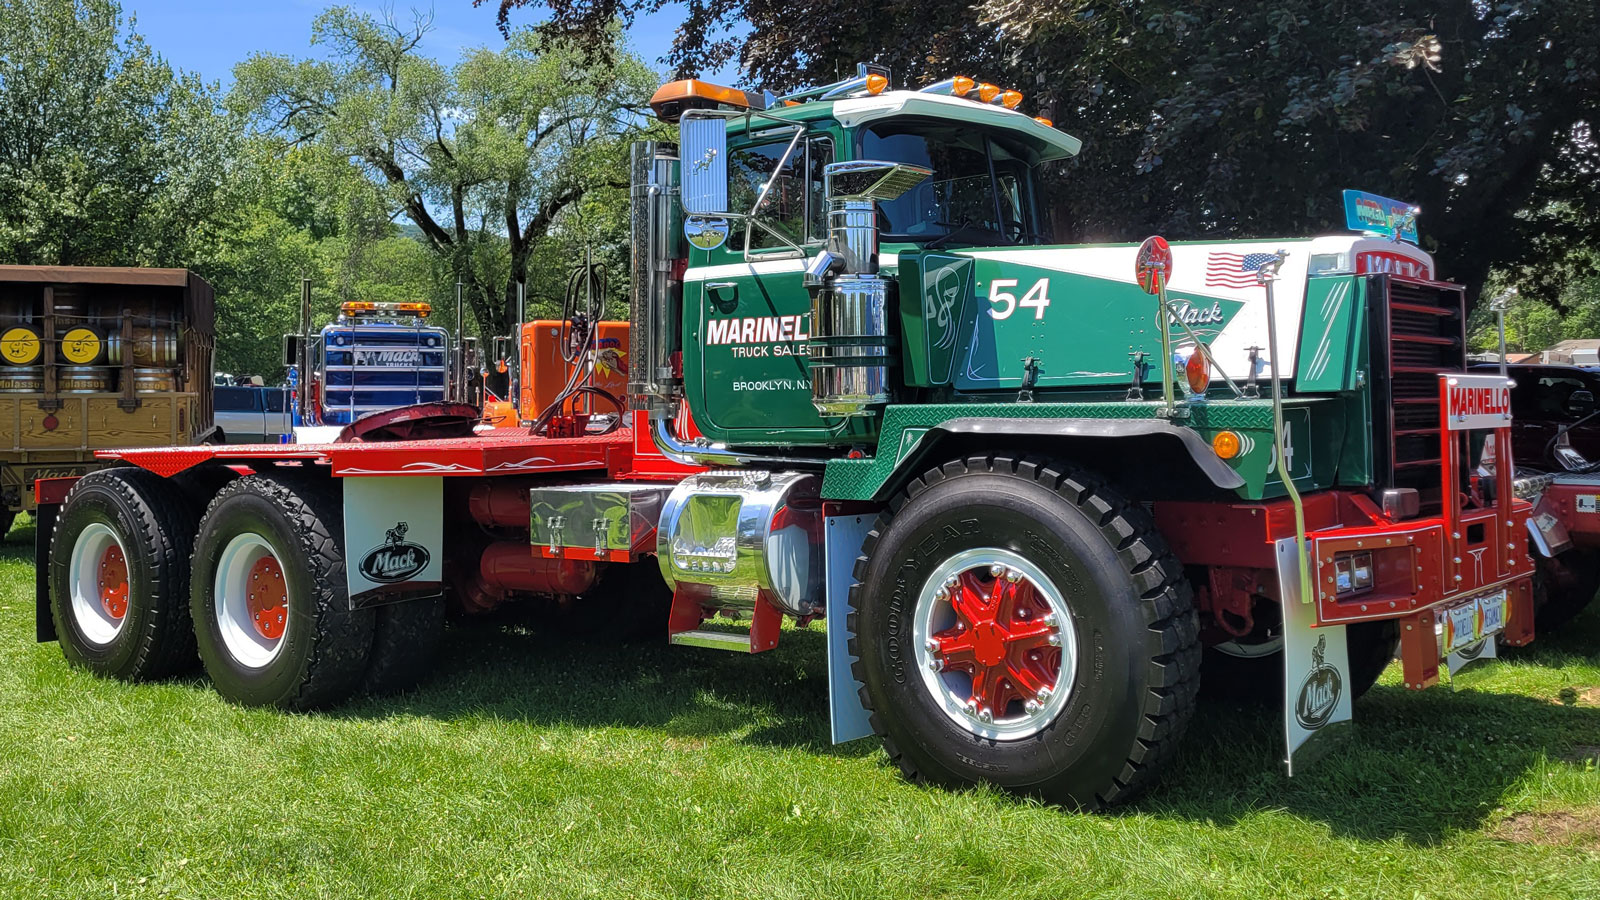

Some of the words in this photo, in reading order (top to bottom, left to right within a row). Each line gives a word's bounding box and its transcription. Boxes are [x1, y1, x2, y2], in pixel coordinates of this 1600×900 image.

[988, 277, 1050, 320] 54
[1167, 301, 1223, 324] Mack
[707, 315, 810, 345] MARINEL
[377, 351, 420, 362] Mack
[731, 346, 769, 359] TRUCK
[773, 345, 811, 356] SALES
[733, 381, 796, 392] BROOKLYN,
[1450, 388, 1509, 416] MARINELLO
[30, 467, 77, 480] Mack
[370, 548, 418, 577] Mack
[1303, 673, 1335, 718] Mack
